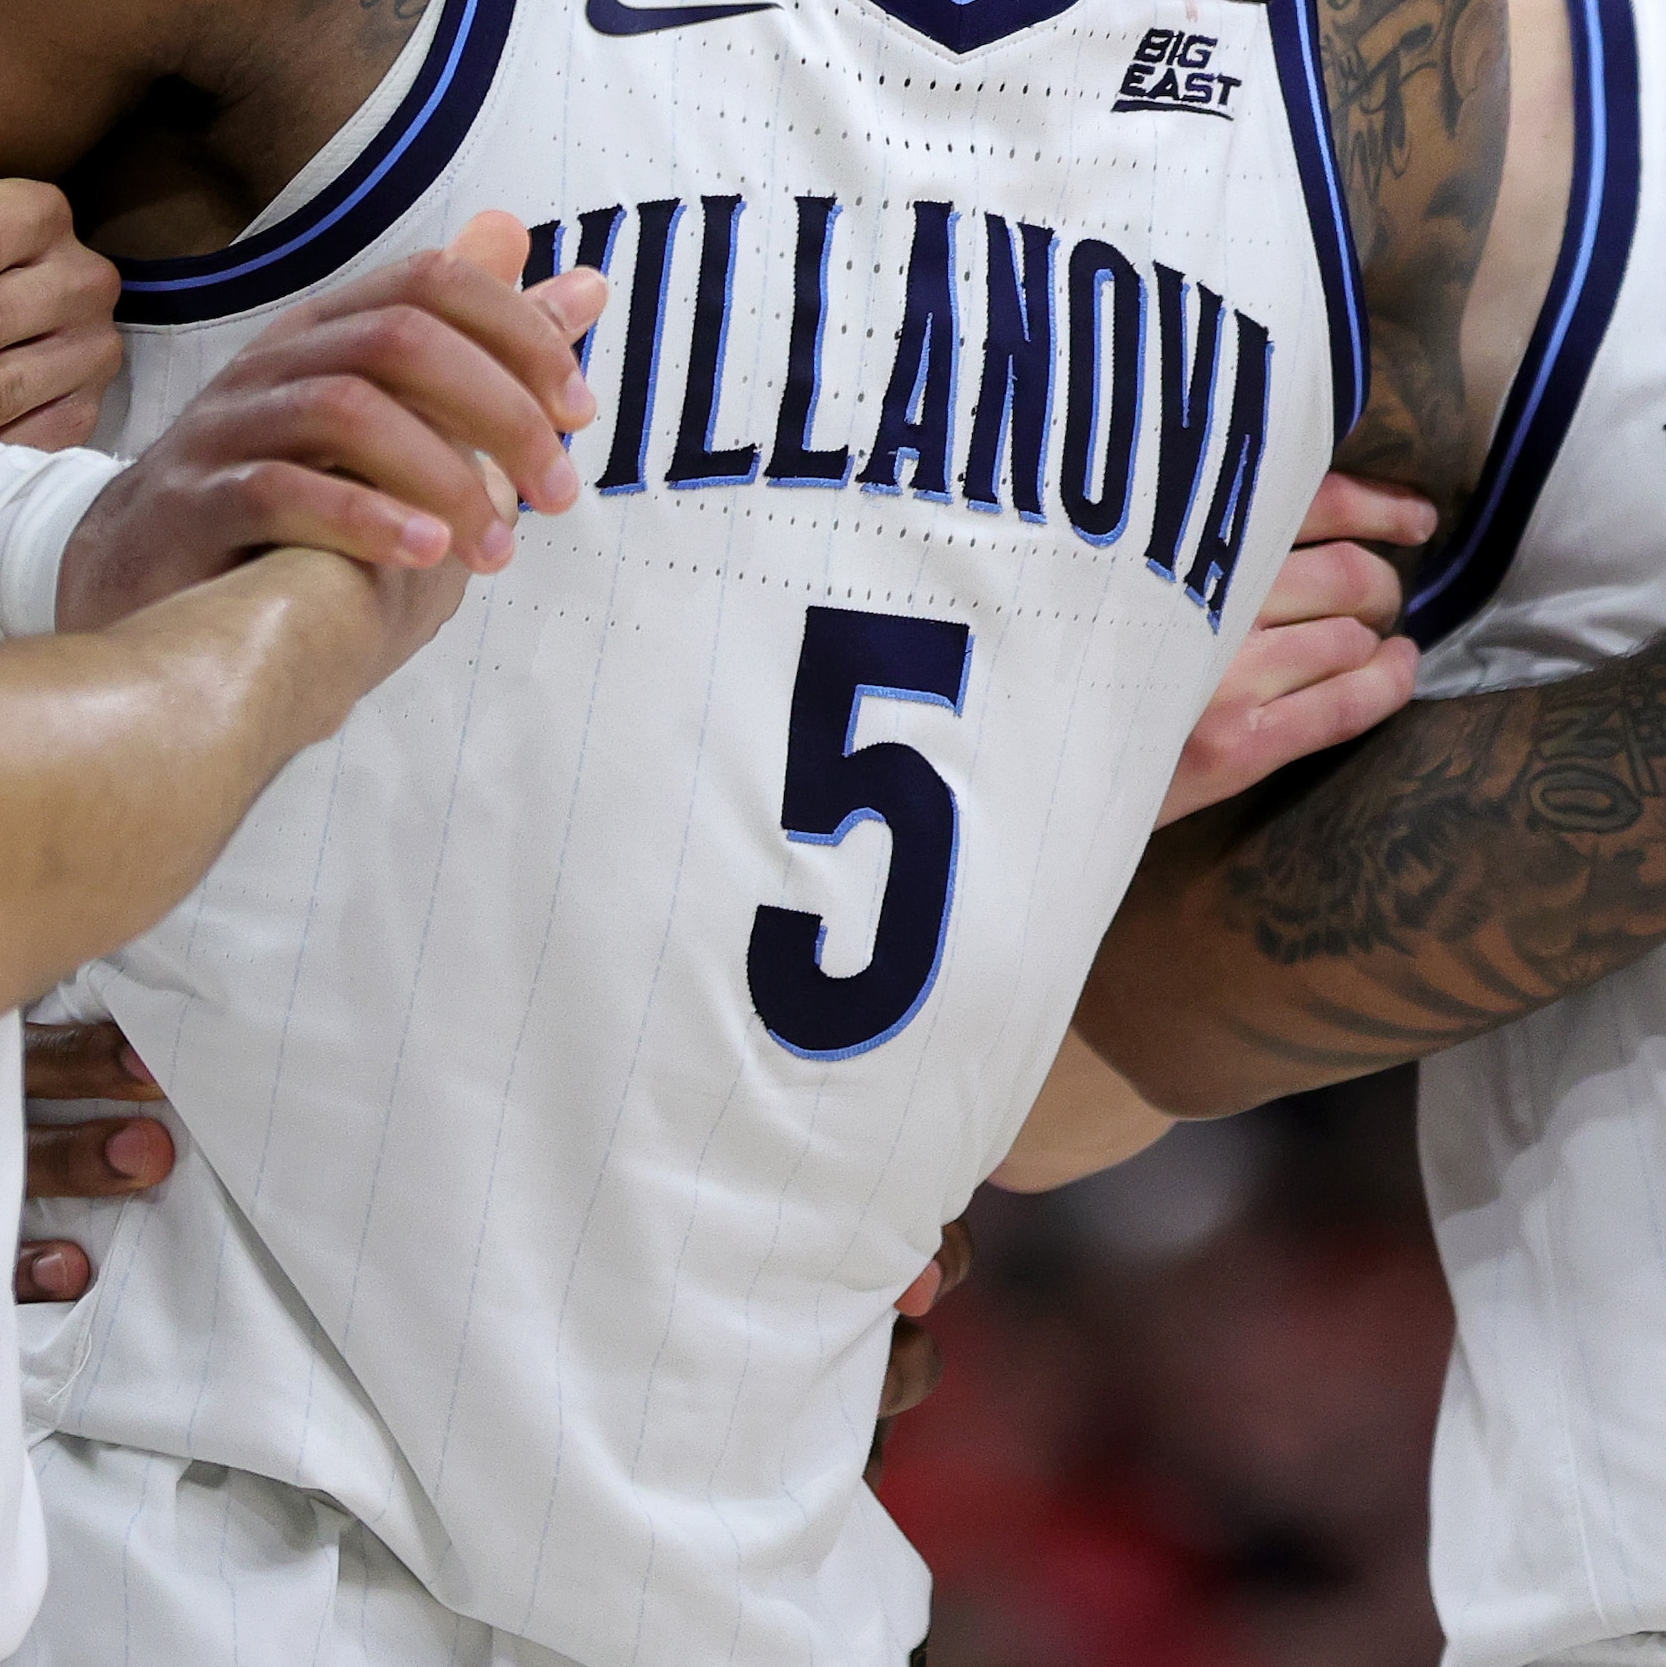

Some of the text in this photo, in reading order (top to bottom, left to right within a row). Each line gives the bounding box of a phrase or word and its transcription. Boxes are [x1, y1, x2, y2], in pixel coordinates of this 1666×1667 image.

[1134, 28, 1218, 68] BIG
[1120, 63, 1242, 106] EAST
[746, 605, 976, 1062] 5
